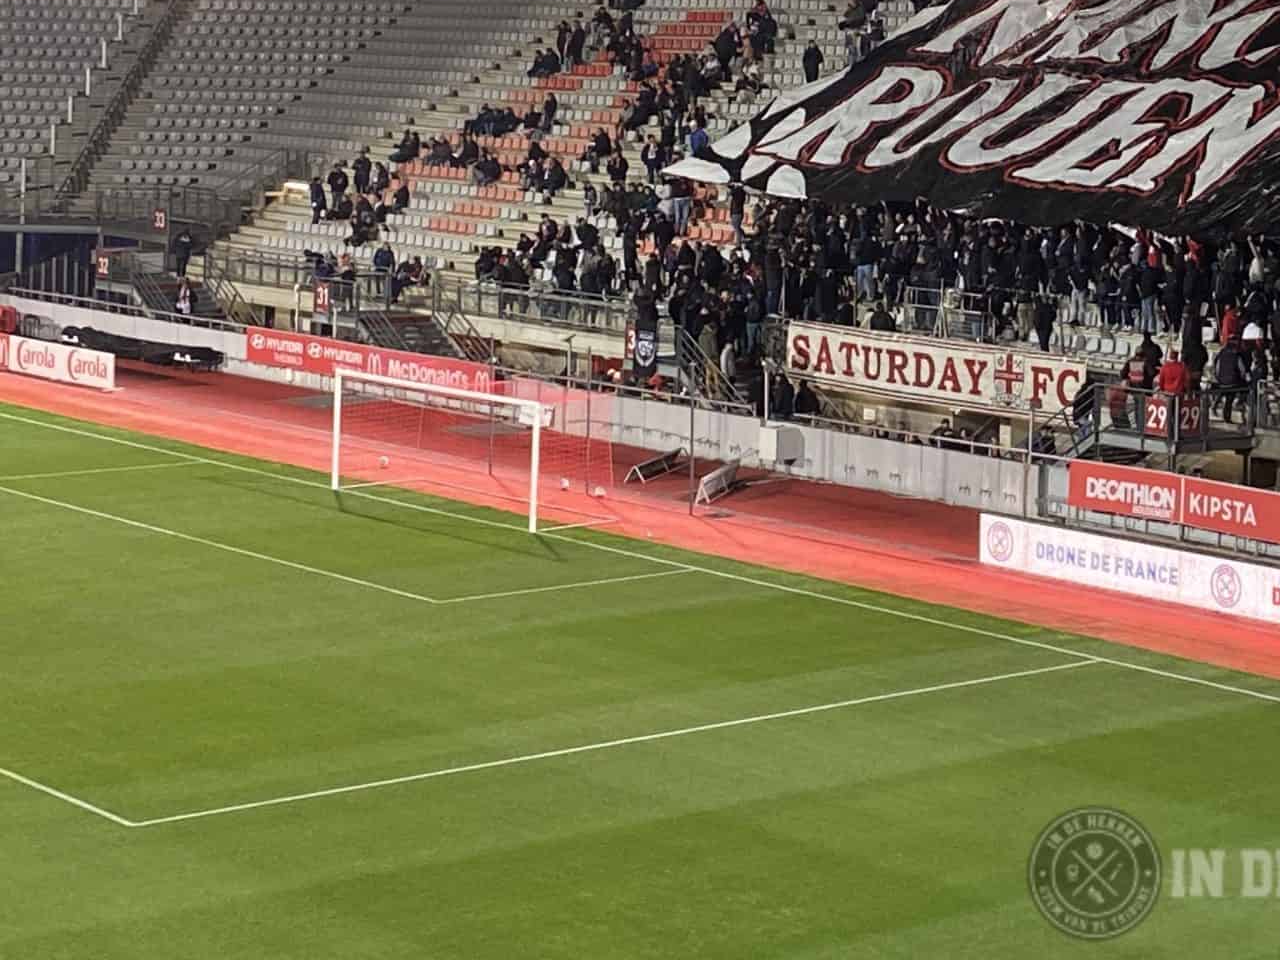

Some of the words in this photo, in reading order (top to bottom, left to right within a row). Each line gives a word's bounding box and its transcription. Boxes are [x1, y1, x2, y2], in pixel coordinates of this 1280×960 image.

[317, 286, 328, 305] 31
[17, 339, 56, 370] Carola
[67, 349, 108, 381] Carola
[388, 359, 469, 387] McDonald's
[791, 335, 988, 396] SATURDAY
[1029, 365, 1080, 409] FC
[1146, 404, 1168, 429] 29
[1180, 406, 1200, 430] 29
[1086, 476, 1176, 510] DECATHLON
[1189, 493, 1257, 526] KIPSTA
[1036, 541, 1086, 568] DRONE
[1090, 550, 1112, 573] DE
[1114, 557, 1179, 586] FRANCE
